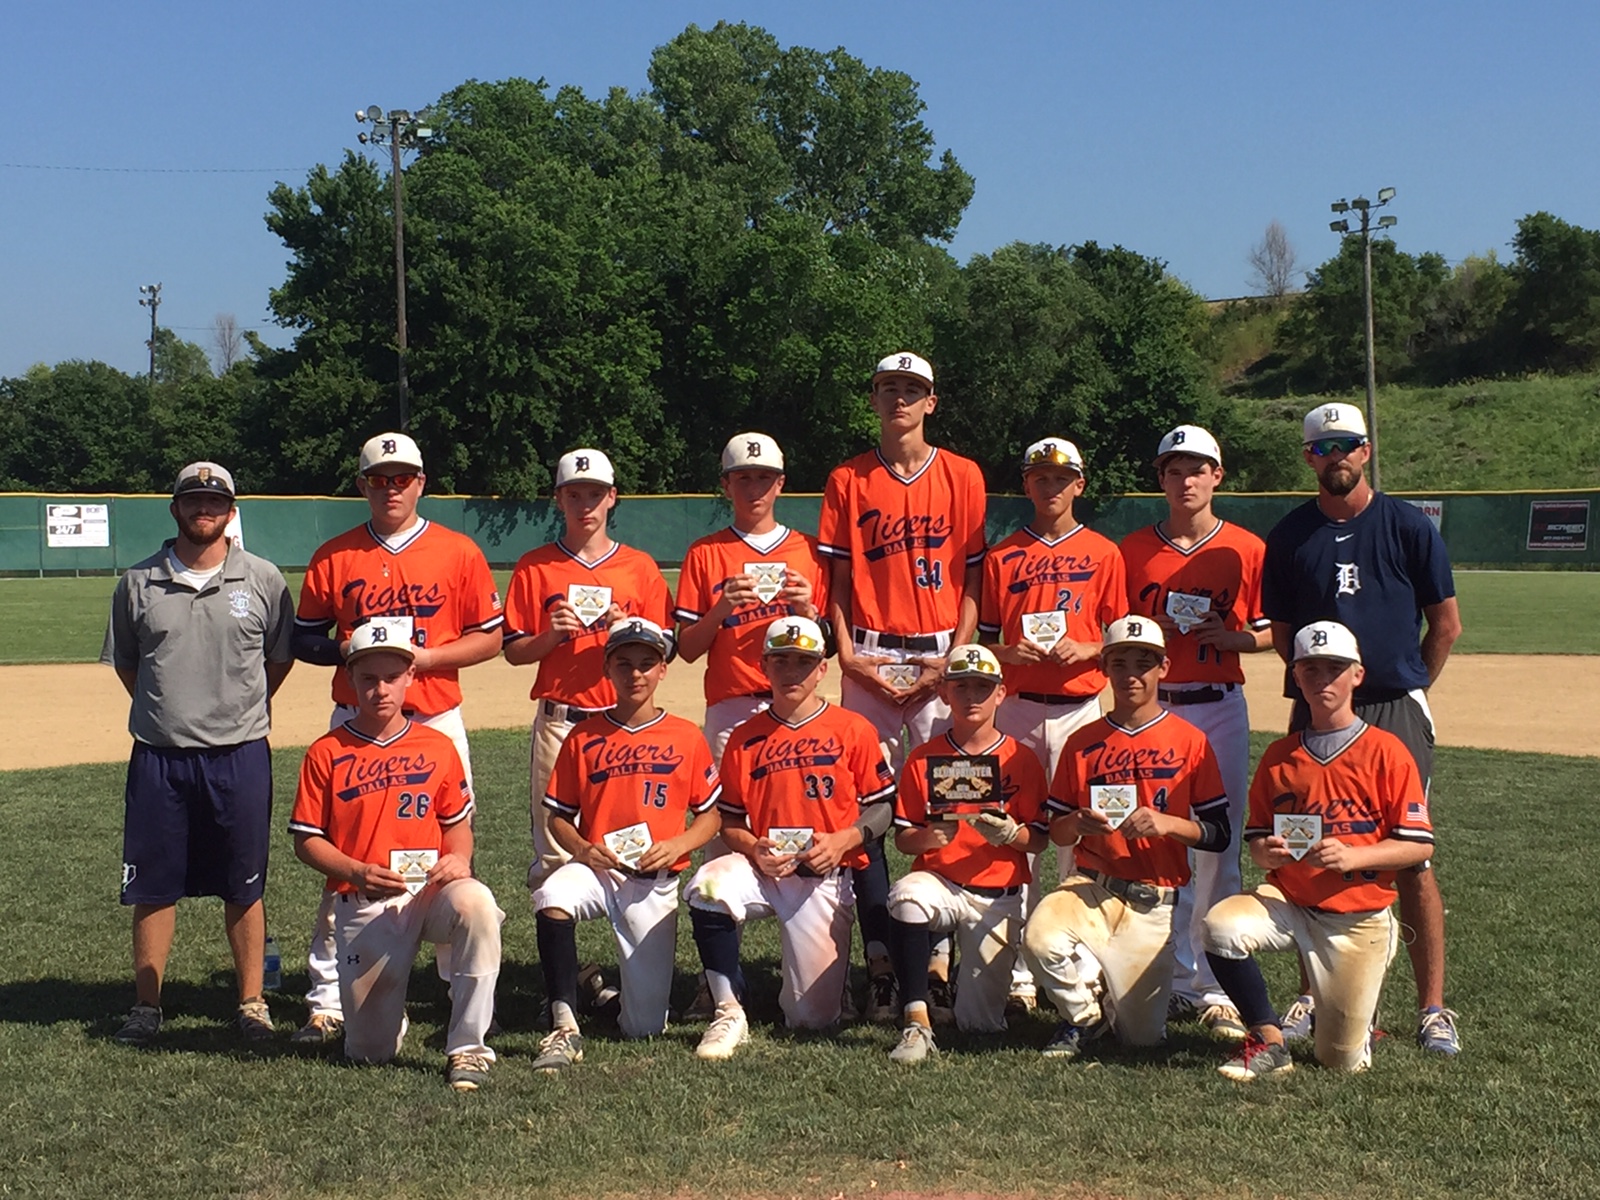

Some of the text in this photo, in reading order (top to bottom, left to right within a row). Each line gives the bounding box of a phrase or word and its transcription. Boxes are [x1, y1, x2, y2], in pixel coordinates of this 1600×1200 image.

[897, 355, 912, 371] D
[1323, 408, 1340, 426] D
[381, 439, 397, 457] D
[746, 441, 762, 459] D
[1170, 430, 1186, 450] D
[575, 456, 590, 474] D
[857, 508, 954, 546] Tigers
[916, 557, 943, 593] 34
[1002, 549, 1100, 580] Tigers
[1335, 562, 1361, 598] D
[342, 578, 447, 617] Tigers
[371, 626, 387, 645] D
[786, 624, 801, 640] D
[1127, 621, 1142, 639] D
[1310, 630, 1328, 649] D
[966, 649, 980, 664] D
[582, 736, 684, 770] Tigers
[744, 735, 844, 767] Tigers
[1082, 740, 1186, 775] Tigers
[332, 753, 436, 787] Tigers
[767, 757, 815, 774] DALLAS
[642, 780, 668, 809] 15
[804, 774, 836, 799] 33
[397, 791, 431, 819] 26
[1152, 787, 1168, 813] 4
